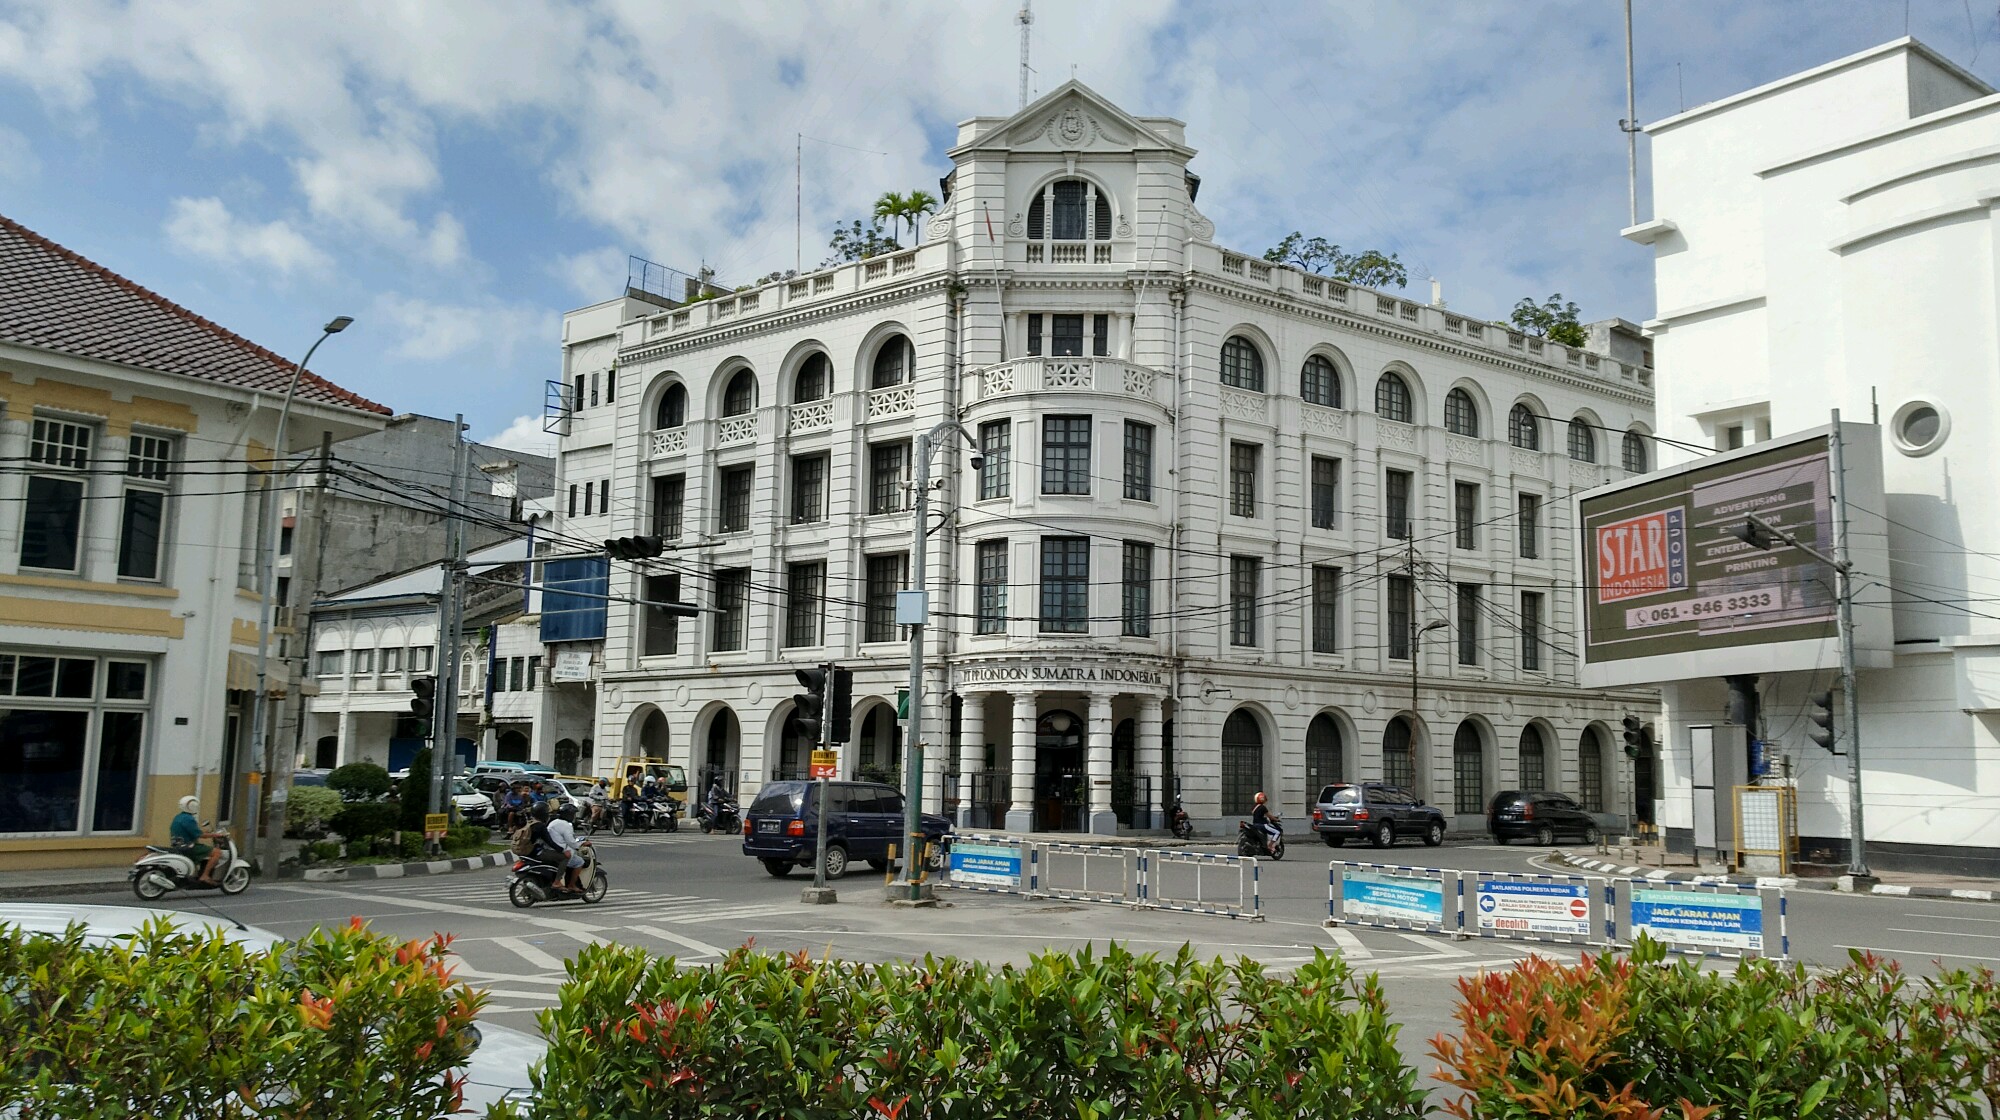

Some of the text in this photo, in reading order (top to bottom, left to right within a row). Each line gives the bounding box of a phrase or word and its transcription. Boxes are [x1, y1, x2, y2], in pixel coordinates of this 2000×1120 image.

[1713, 493, 1786, 516] ADVERTISING
[1602, 519, 1665, 579] STAR
[1670, 515, 1682, 584] GROUP
[1707, 532, 1796, 556] ENTERTA
[1725, 557, 1778, 573] PRINTING
[1603, 575, 1665, 598] INDONESIA
[1651, 607, 1679, 622] 061
[1692, 600, 1723, 615] 846
[1728, 593, 1771, 611] 3333
[981, 668, 1028, 680] LONDON
[1032, 667, 1096, 680] SUMATRA
[1101, 669, 1154, 684] INDONESIA
[1372, 890, 1419, 902] SEPEDA MOTOR
[1496, 919, 1528, 929] decolith
[1651, 908, 1740, 920] JAGA JARAK AMAN
